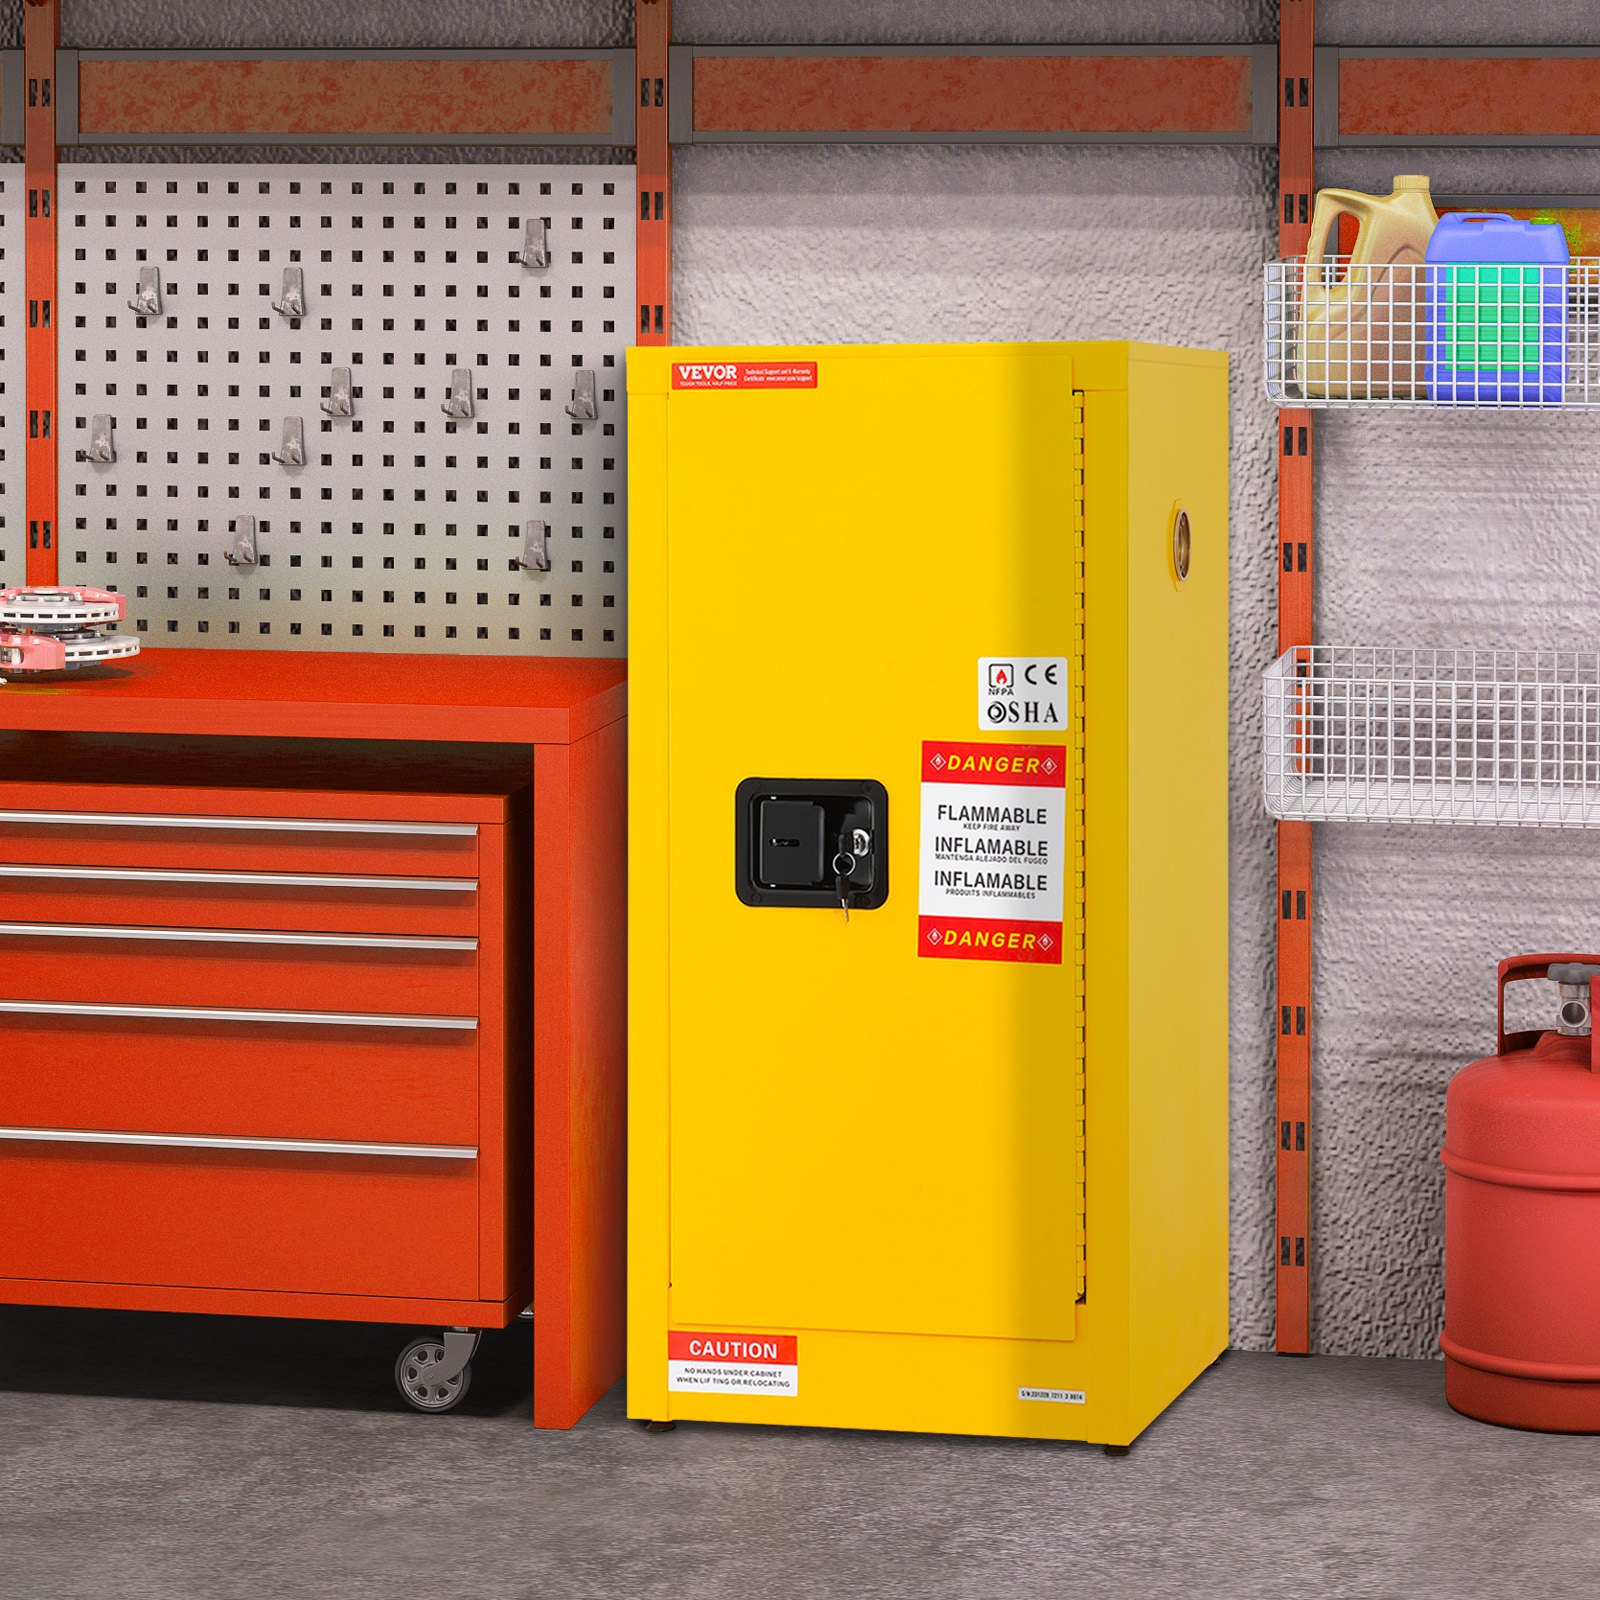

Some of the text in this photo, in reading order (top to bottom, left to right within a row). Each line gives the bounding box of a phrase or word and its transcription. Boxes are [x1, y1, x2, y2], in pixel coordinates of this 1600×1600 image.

[678, 365, 738, 380] VEVOR
[988, 688, 1014, 696] NFPA
[987, 701, 1059, 724] OSHA
[947, 754, 1041, 773] DANGER
[938, 804, 1048, 825] FLAMMABLE
[963, 822, 1021, 832] KEEP FIRE AWAY
[935, 836, 1048, 857] INFLAMABLE
[935, 853, 974, 862] MANTENGA
[975, 855, 1008, 864] ALEJADO
[1009, 856, 1022, 864] DEL
[934, 870, 1048, 891] INFLAMABLE
[945, 888, 1036, 899] PRODUITS INFLAMMABLES
[944, 930, 1037, 949] DANGER
[689, 1340, 778, 1359] CAUTION
[723, 1369, 749, 1377] UNDER
[749, 1370, 782, 1378] CABINET
[743, 1379, 791, 1388] RELOCATING
